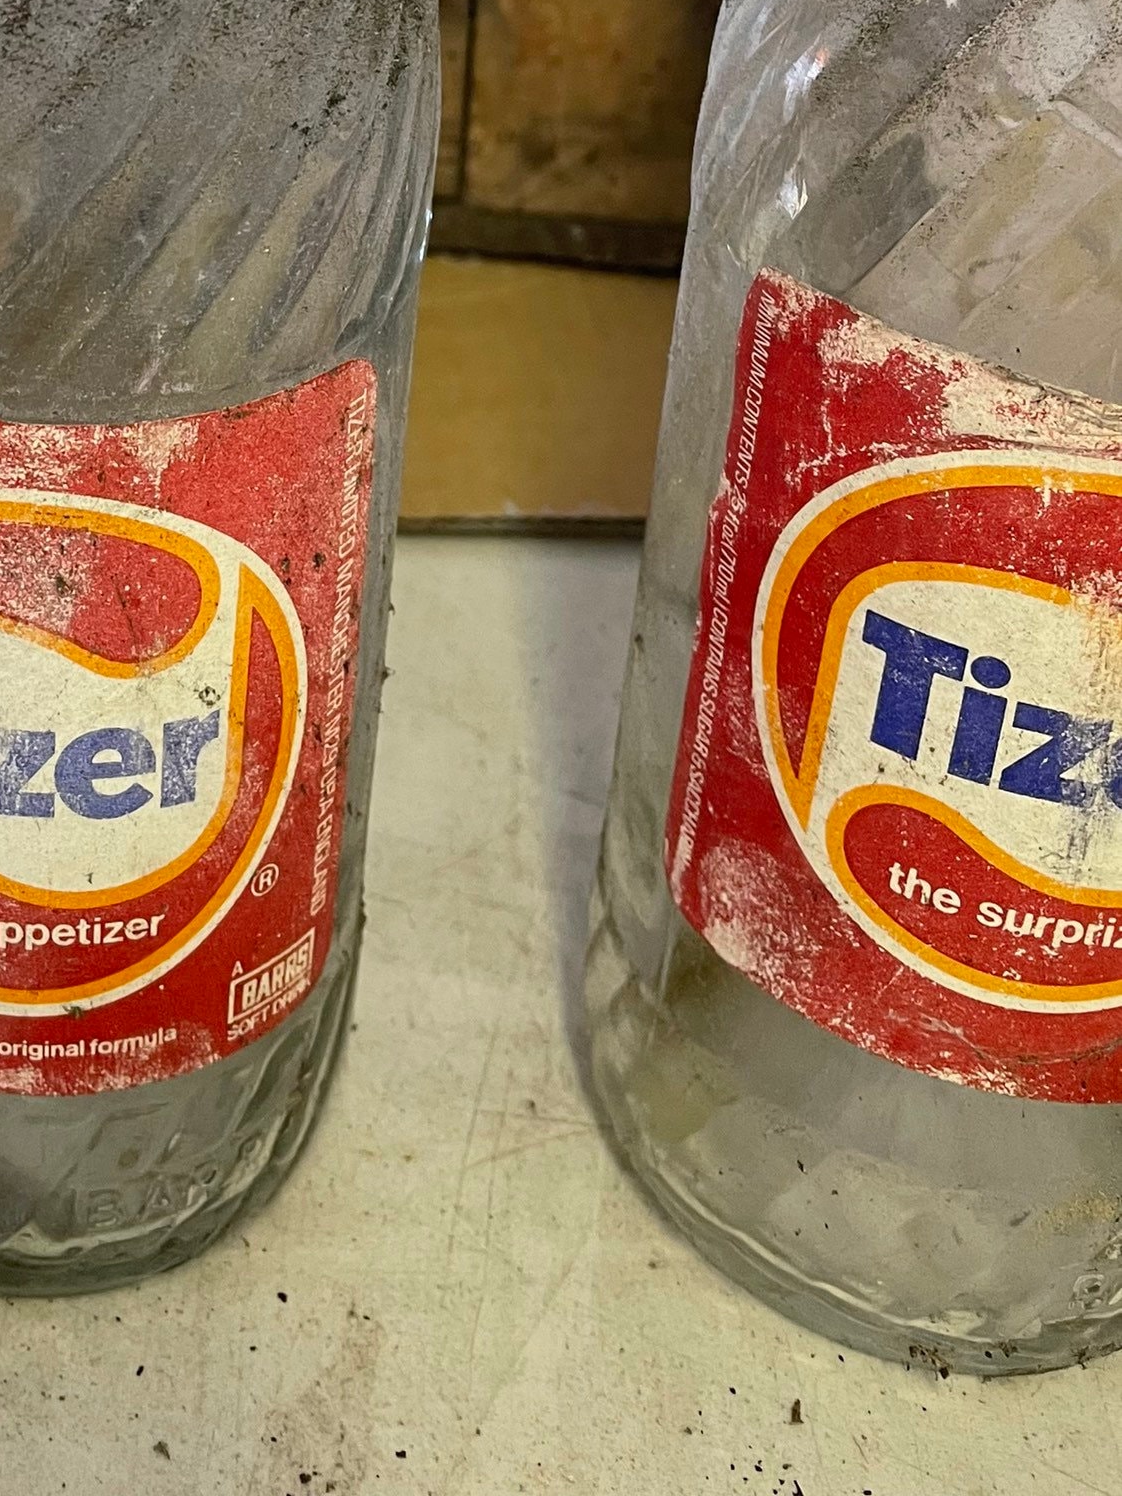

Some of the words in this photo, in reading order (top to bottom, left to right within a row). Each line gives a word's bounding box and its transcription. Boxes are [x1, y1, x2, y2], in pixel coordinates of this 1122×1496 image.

[749, 289, 776, 388] MINIMUM
[344, 387, 368, 463] TIZER
[733, 386, 763, 489] CONTENTS
[337, 461, 361, 559] LIMITED
[325, 557, 352, 716] MANCHESTER
[701, 608, 729, 699] CONTAINS
[320, 712, 342, 768] M29
[692, 695, 716, 757] SUGAR
[309, 812, 332, 917] ENGLAND
[888, 862, 961, 914] the
[241, 941, 310, 1011] BARRS
[89, 1024, 178, 1057] formula
[227, 1006, 269, 1041] SOFT
